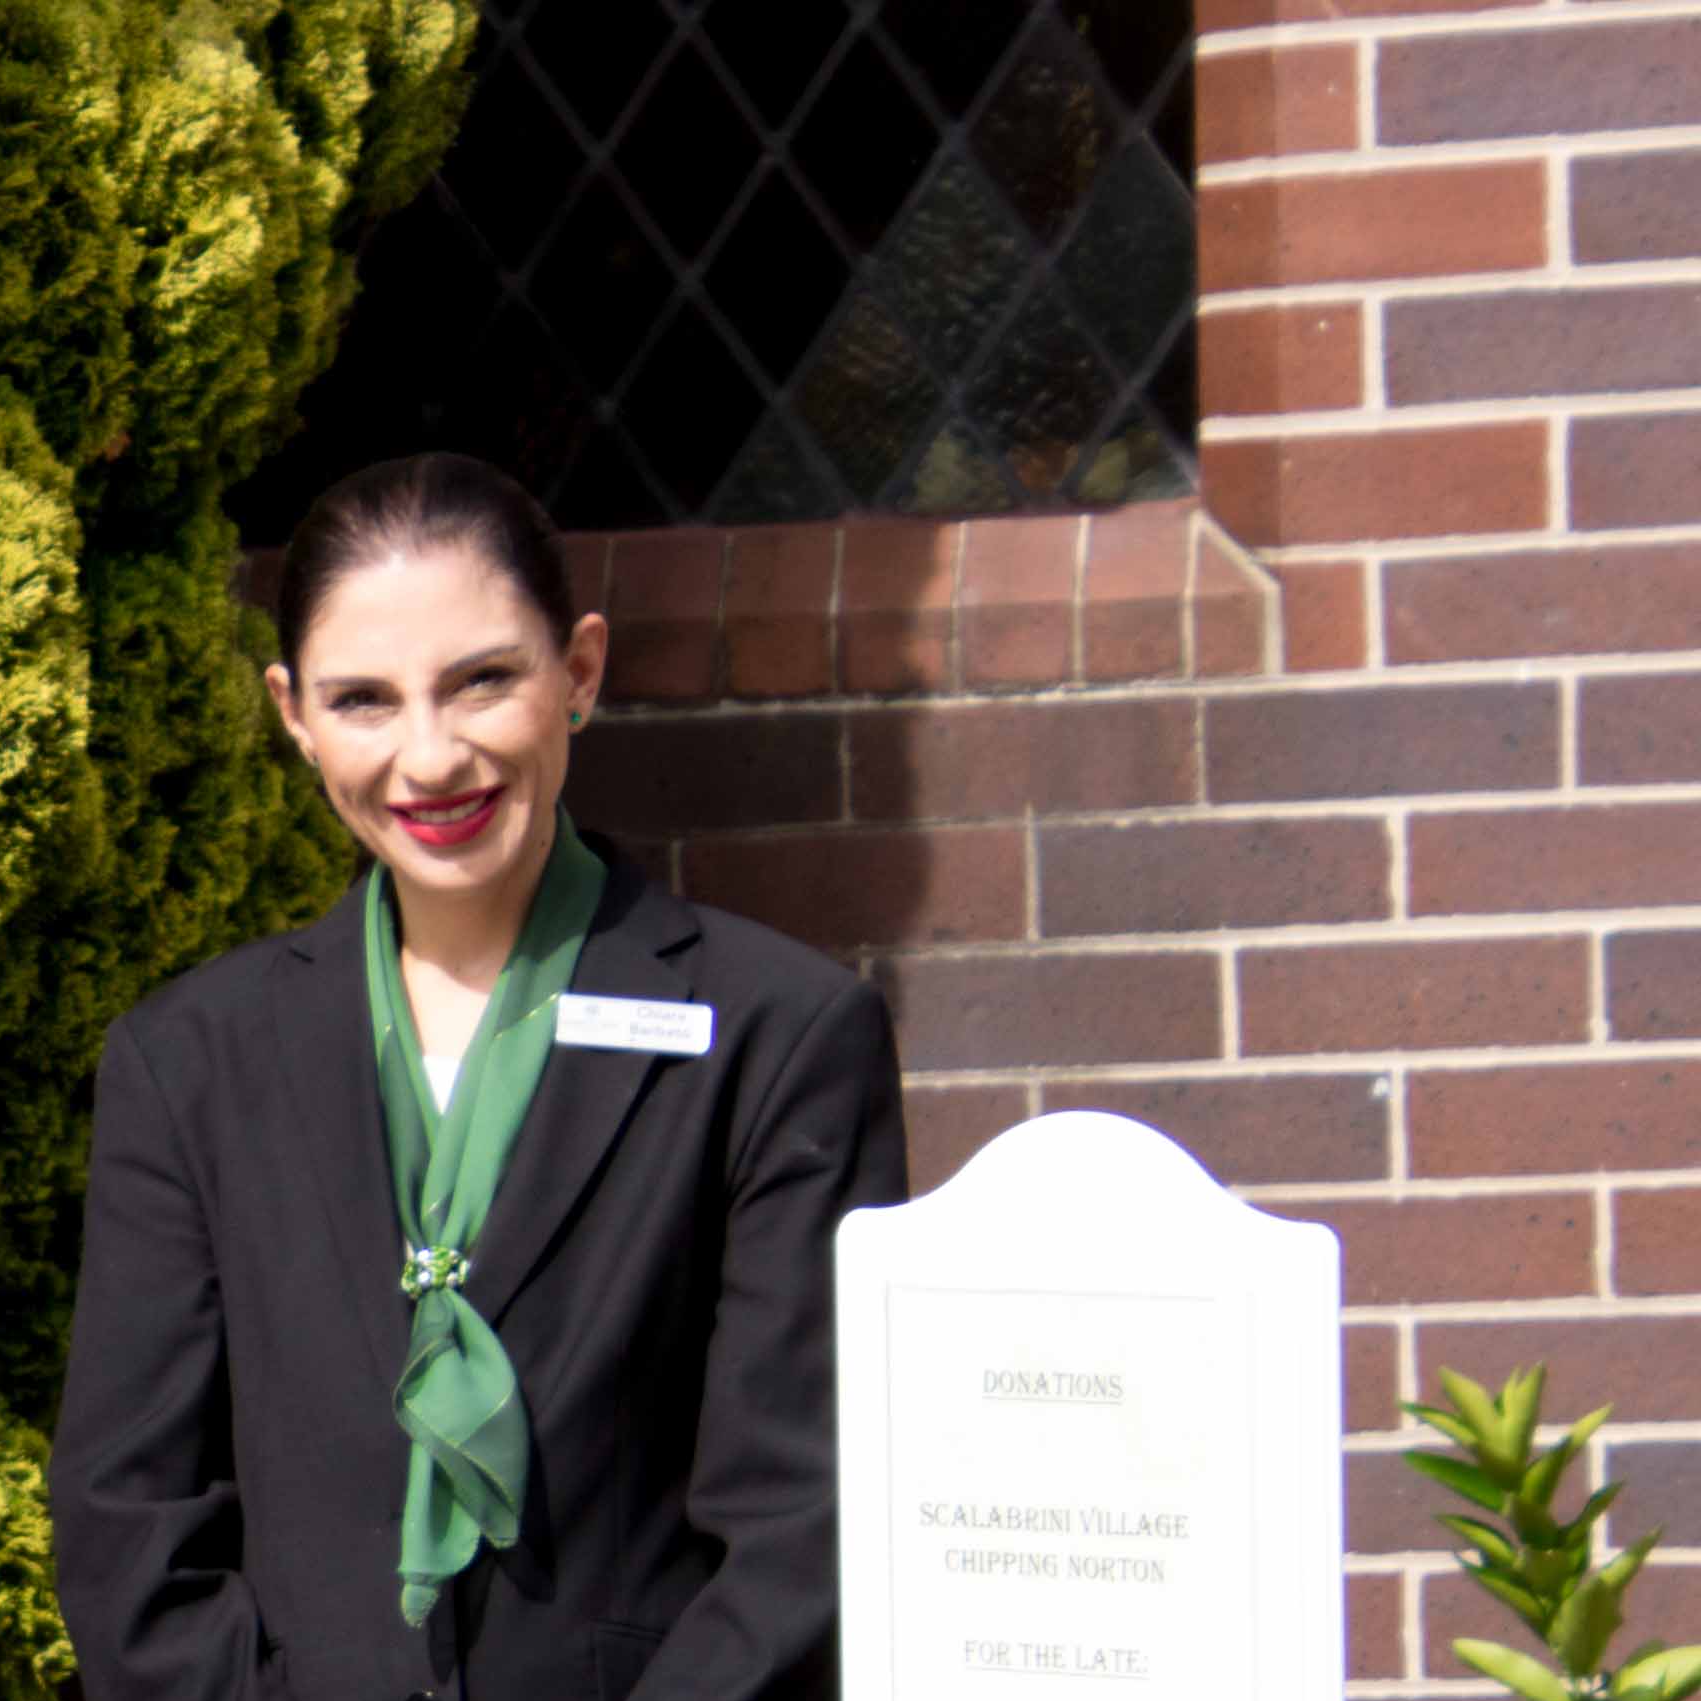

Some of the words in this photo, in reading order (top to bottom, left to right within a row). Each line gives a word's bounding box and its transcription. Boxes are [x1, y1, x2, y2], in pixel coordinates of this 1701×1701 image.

[983, 1368, 1124, 1399] DONATIONS
[919, 1501, 1071, 1534] SCALABRINI
[1078, 1505, 1190, 1539] VILLAGE
[944, 1548, 1059, 1579] CHIPPING
[1068, 1554, 1166, 1583] NORTON
[964, 1639, 1011, 1667] FOR
[1017, 1641, 1066, 1669] THE
[1075, 1645, 1149, 1674] LATE:
